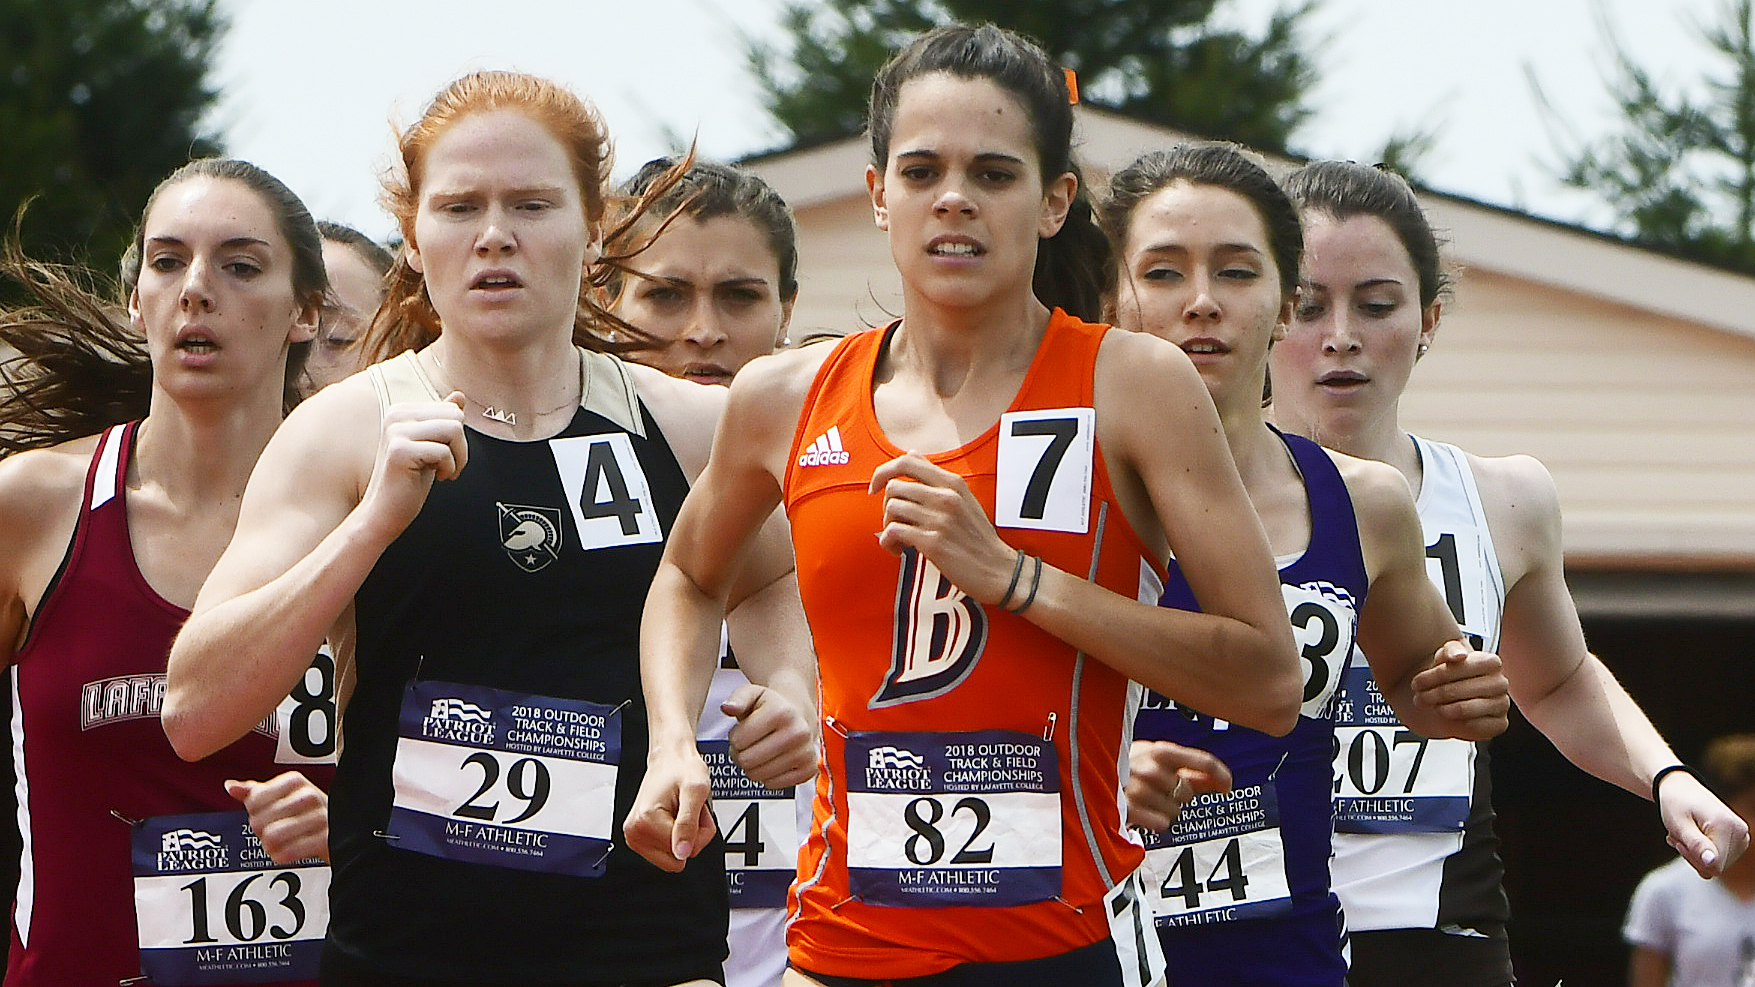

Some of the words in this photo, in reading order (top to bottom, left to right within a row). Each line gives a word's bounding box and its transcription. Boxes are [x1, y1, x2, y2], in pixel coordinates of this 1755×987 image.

[799, 450, 849, 465] adidas
[1011, 418, 1078, 519] 7
[580, 441, 642, 535] 4
[1425, 533, 1465, 625] 1
[1291, 602, 1338, 703] 3
[290, 654, 336, 757] 8
[424, 716, 496, 735] PATRIOT
[511, 705, 541, 719] 2018
[544, 709, 605, 728] OUTDOOR
[423, 727, 495, 745] LEAGUE
[515, 718, 552, 733] TRACK
[556, 723, 566, 734] &
[570, 724, 600, 739] FIELD
[505, 743, 532, 752] HOSTED
[507, 730, 606, 752] CHAMPIONSHIPS
[945, 745, 975, 757] 2018
[978, 744, 1040, 757] OUTDOOR
[708, 765, 738, 777] RACK
[949, 757, 988, 769] TRACK
[992, 757, 1002, 768] &
[1006, 757, 1037, 769] FIELD
[865, 767, 931, 780] PATRIOT
[943, 770, 1043, 783] CHAMPIONSHIPS
[453, 752, 551, 824] 29
[866, 778, 932, 790] LEAGUE
[1216, 805, 1226, 815] &
[1229, 799, 1259, 814] FIELD
[1349, 800, 1414, 812] ATHLETIC
[904, 797, 995, 865] 82
[1171, 809, 1266, 835] CHAMPIONSHIPS
[446, 822, 473, 838] M-F
[476, 827, 549, 848] ATHLETIC
[157, 846, 229, 862] PATRIOT
[157, 857, 229, 871] LEAGUE
[898, 871, 925, 884] M-F
[927, 870, 1000, 884] ATHLETIC
[1150, 838, 1249, 909] 44
[181, 872, 306, 944] 163
[197, 949, 222, 961] M-F
[227, 944, 292, 960] ATHLETIC
